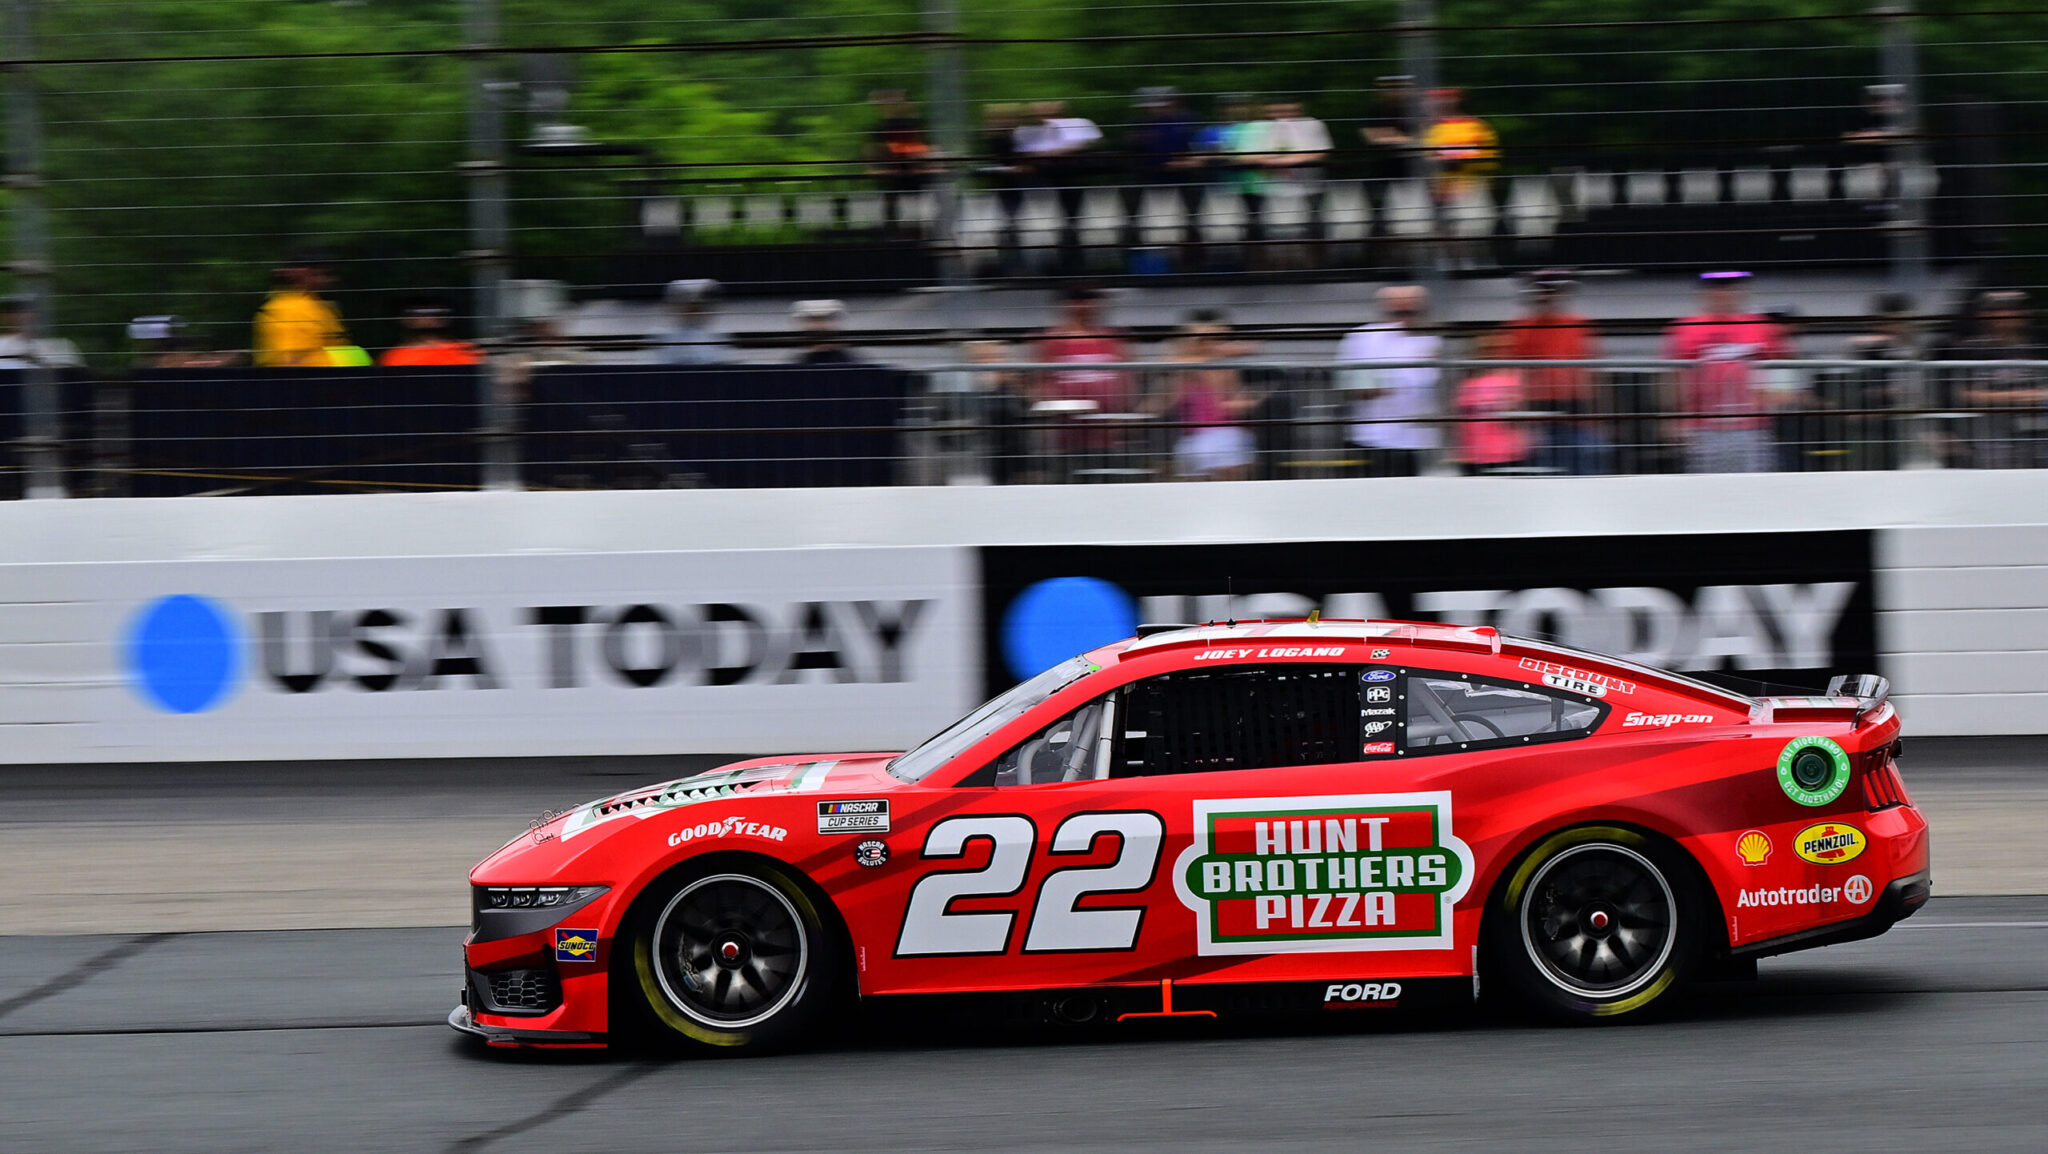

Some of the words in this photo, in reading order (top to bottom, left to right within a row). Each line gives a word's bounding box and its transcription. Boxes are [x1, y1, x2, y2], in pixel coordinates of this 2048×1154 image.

[258, 607, 508, 694] USA
[514, 599, 935, 690] TODAY
[1194, 649, 1254, 660] JOEY
[1257, 647, 1346, 658] LOGANO
[1519, 657, 1636, 694] DISCOUNT
[1550, 676, 1599, 694] TIRE
[1369, 688, 1389, 701] PPG
[1361, 708, 1396, 717] Mazak
[1623, 712, 1713, 727] Snap-on
[1781, 747, 1794, 762] GET
[839, 803, 877, 813] NASCAR
[827, 817, 847, 827] CUP
[847, 816, 879, 826] SERIES
[1255, 818, 1390, 855] HUNT
[1804, 833, 1855, 854] PENNZOIL
[1203, 854, 1446, 893] BROTHERS
[892, 810, 1166, 958] 22
[1737, 883, 1842, 908] Autotrader
[1255, 891, 1396, 929] PIZZA
[559, 941, 596, 950] SUNOCO
[1324, 983, 1402, 1001] FORD
